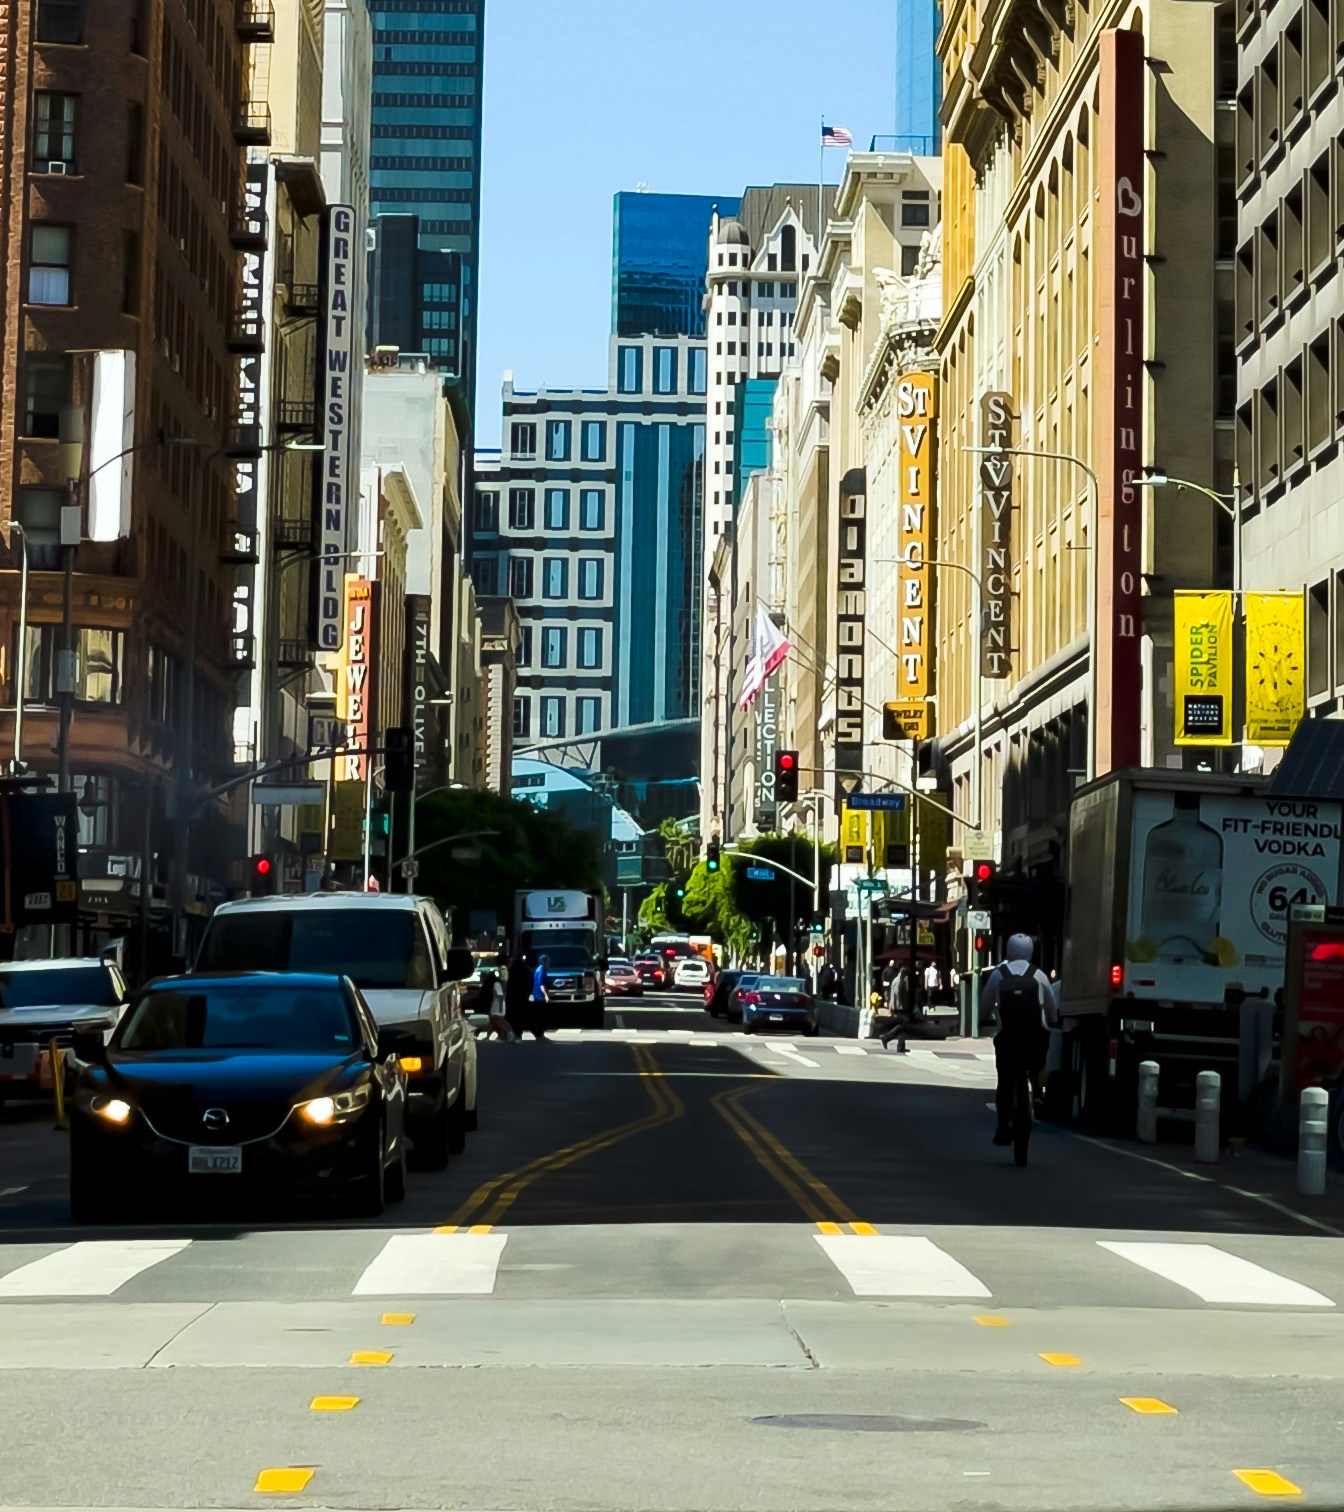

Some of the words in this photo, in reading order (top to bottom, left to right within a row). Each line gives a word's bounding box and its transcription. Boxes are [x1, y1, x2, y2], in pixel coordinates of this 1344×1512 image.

[331, 210, 350, 338] GREAT
[897, 382, 929, 417] ST
[325, 348, 348, 532] WESTERN
[900, 424, 926, 684] VINCENT
[983, 490, 1011, 674] VINCENT
[322, 543, 340, 647] BLDG
[415, 624, 427, 664] 7TH
[1190, 624, 1204, 688] SPIDER
[1207, 624, 1218, 688] PAVILION
[761, 672, 777, 802] LLECTION
[851, 796, 901, 808] Broadway
[1266, 801, 1318, 818] YOUR
[1255, 838, 1326, 857] VODKA
